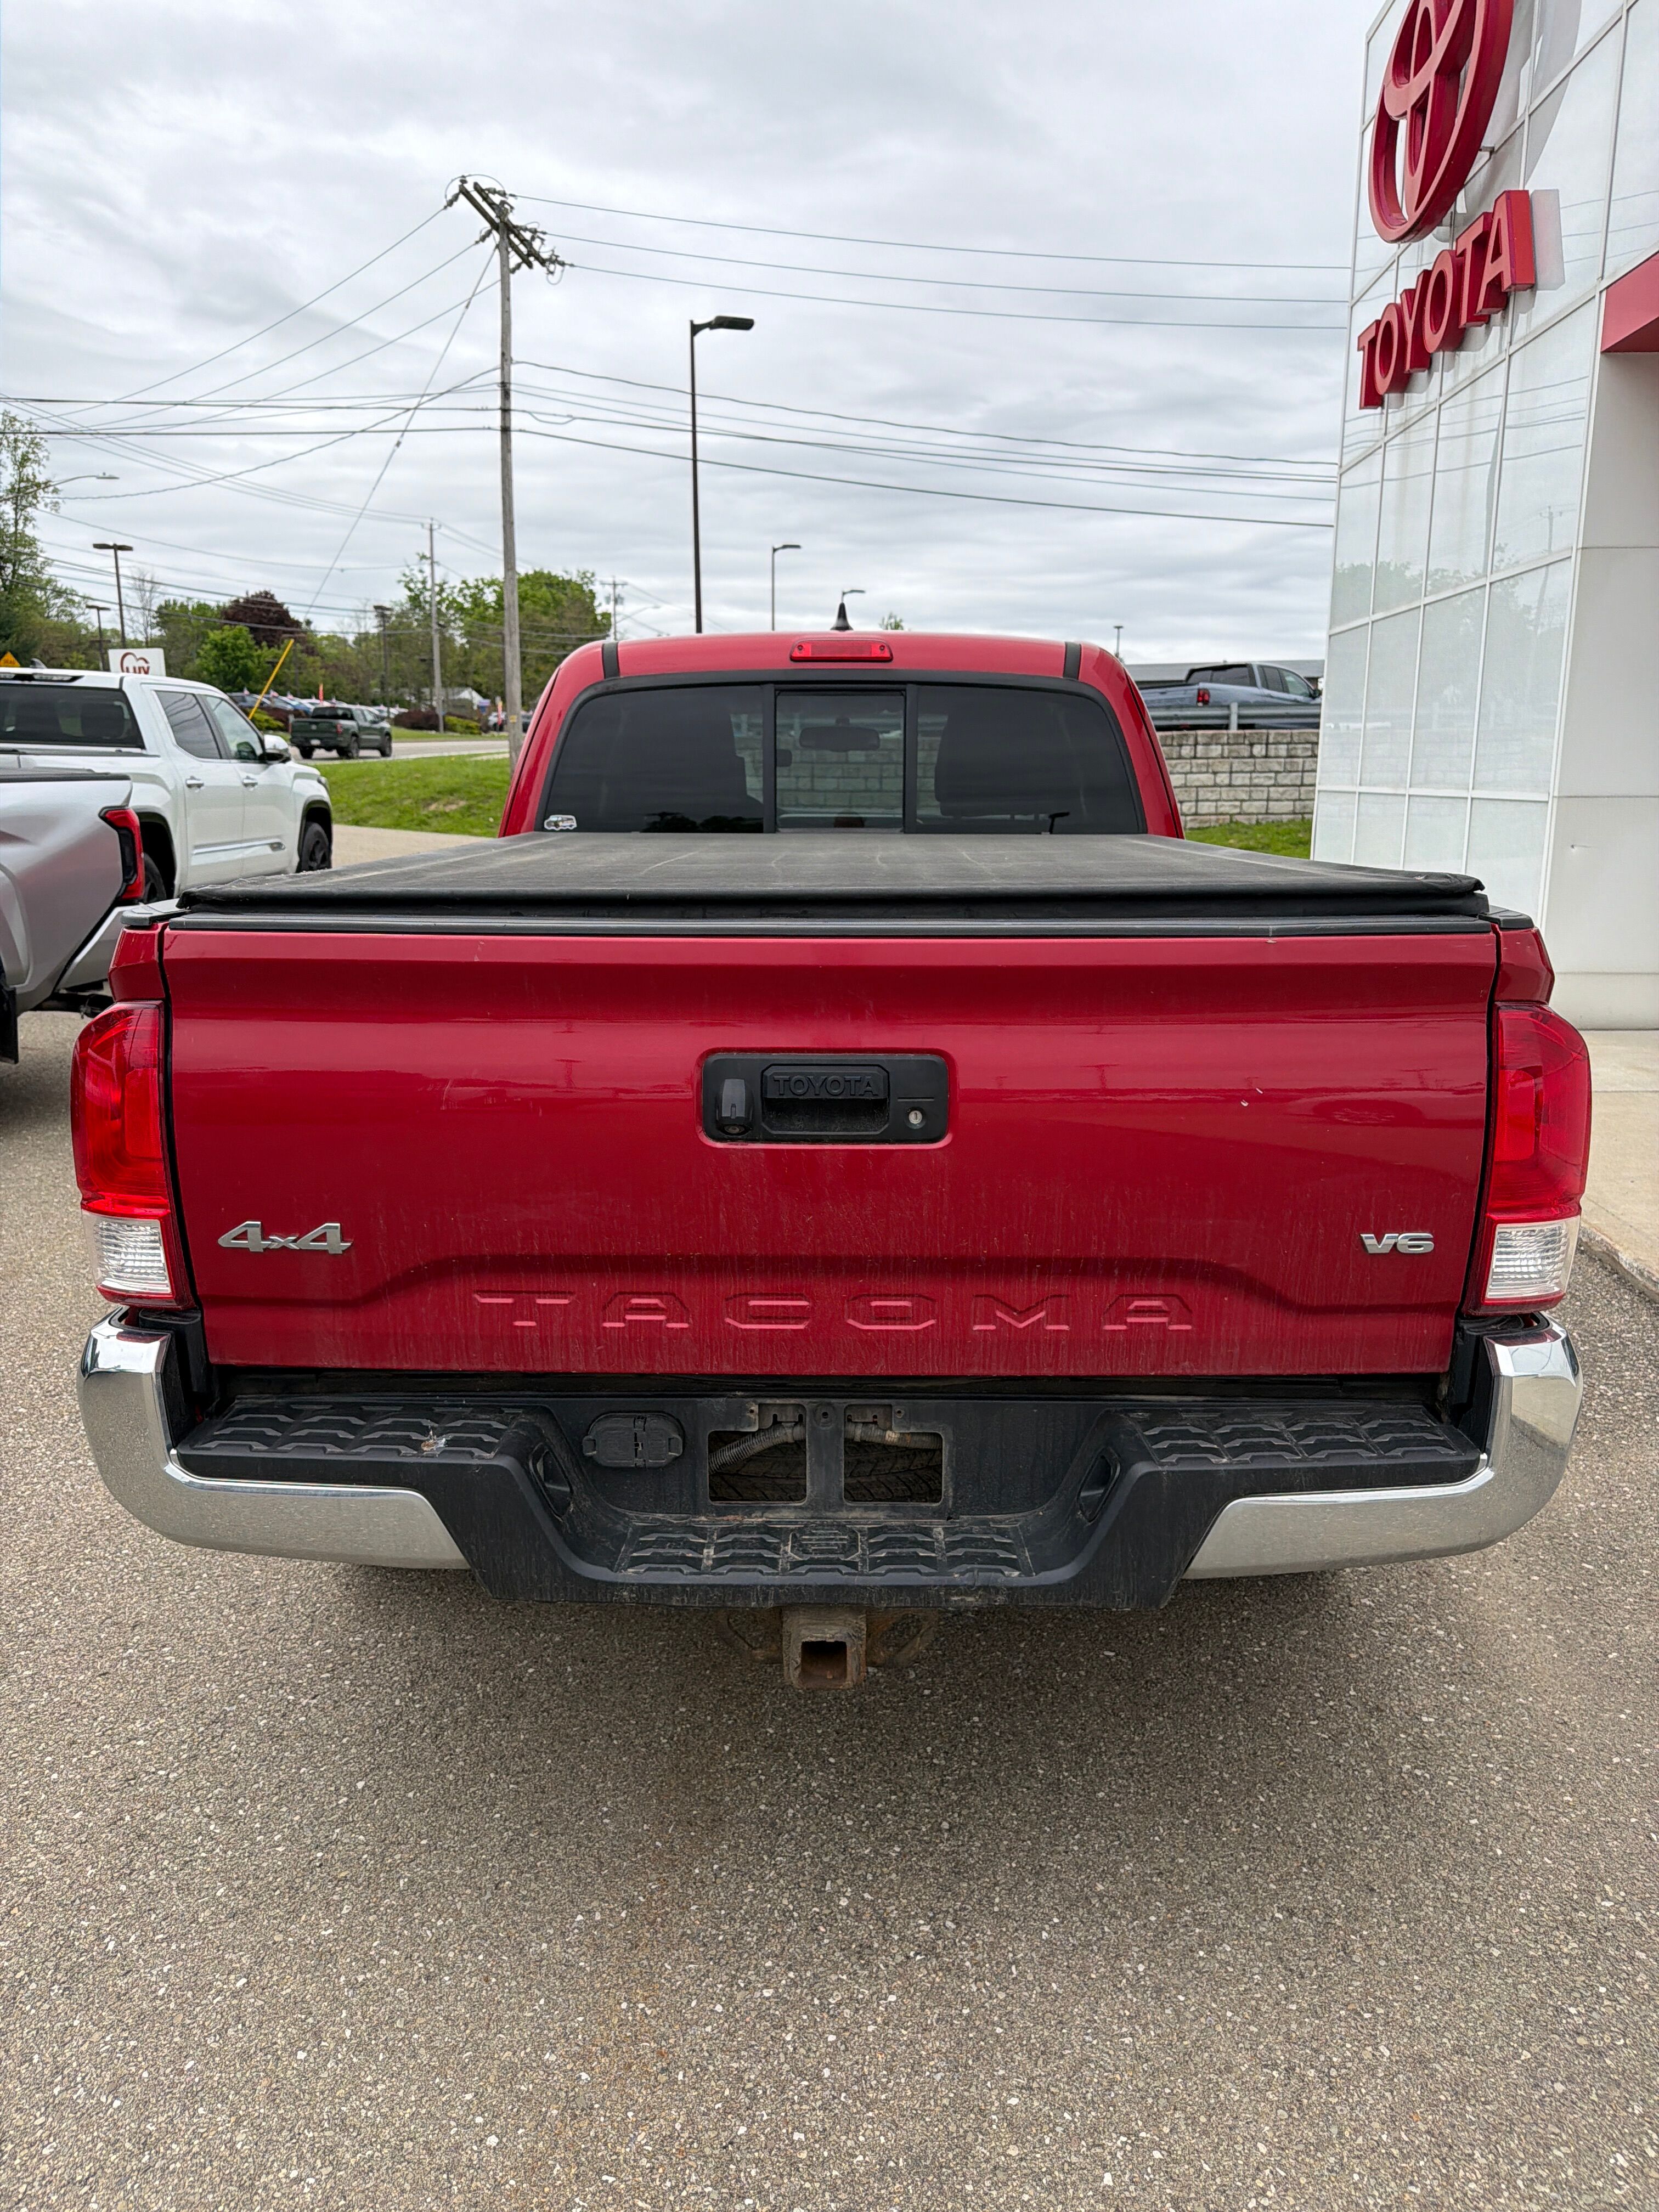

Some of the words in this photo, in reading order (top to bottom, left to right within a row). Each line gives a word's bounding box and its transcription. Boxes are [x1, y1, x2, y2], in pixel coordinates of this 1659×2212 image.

[1357, 190, 1534, 409] TOYOTA
[774, 1074, 879, 1097] TOYOTA
[218, 1221, 352, 1254] 4x4
[1360, 1232, 1435, 1254] V6
[473, 1290, 1193, 1330] TACOMA
